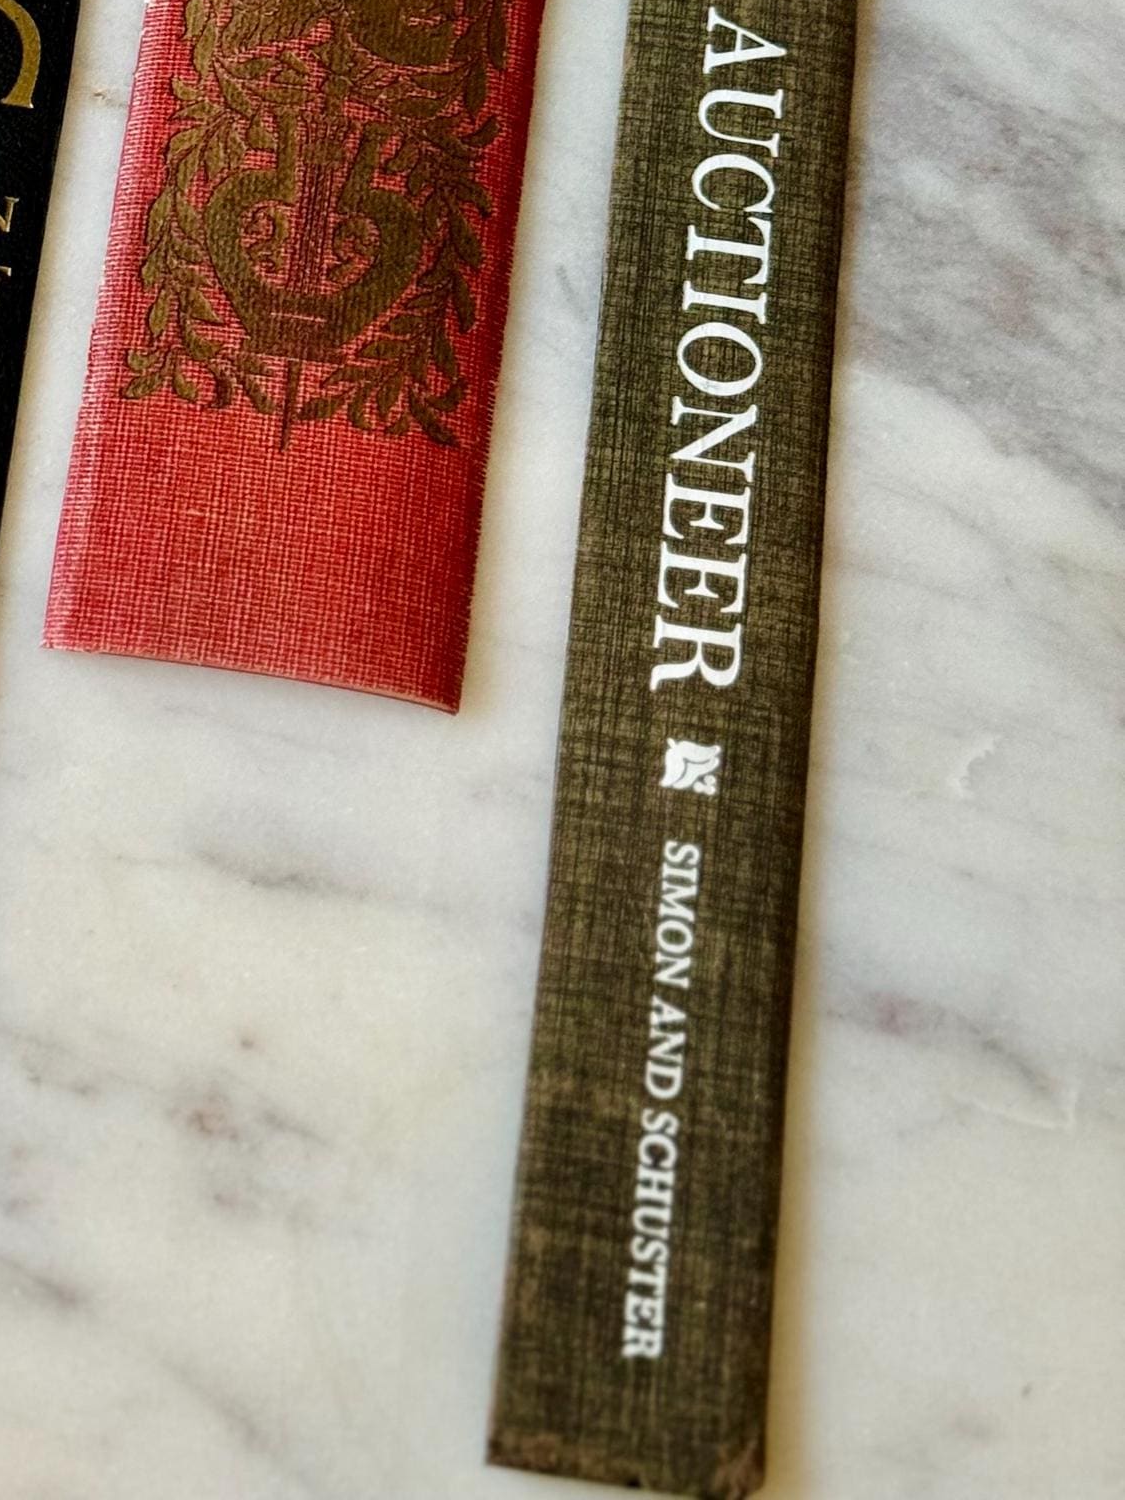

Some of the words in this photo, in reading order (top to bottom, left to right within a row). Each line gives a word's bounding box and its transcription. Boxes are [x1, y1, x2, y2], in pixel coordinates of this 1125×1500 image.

[650, 6, 787, 692] AUCTIONEER
[652, 840, 701, 989] SIMON
[644, 995, 687, 1100] AND
[620, 1107, 679, 1360] SCHUSTER
